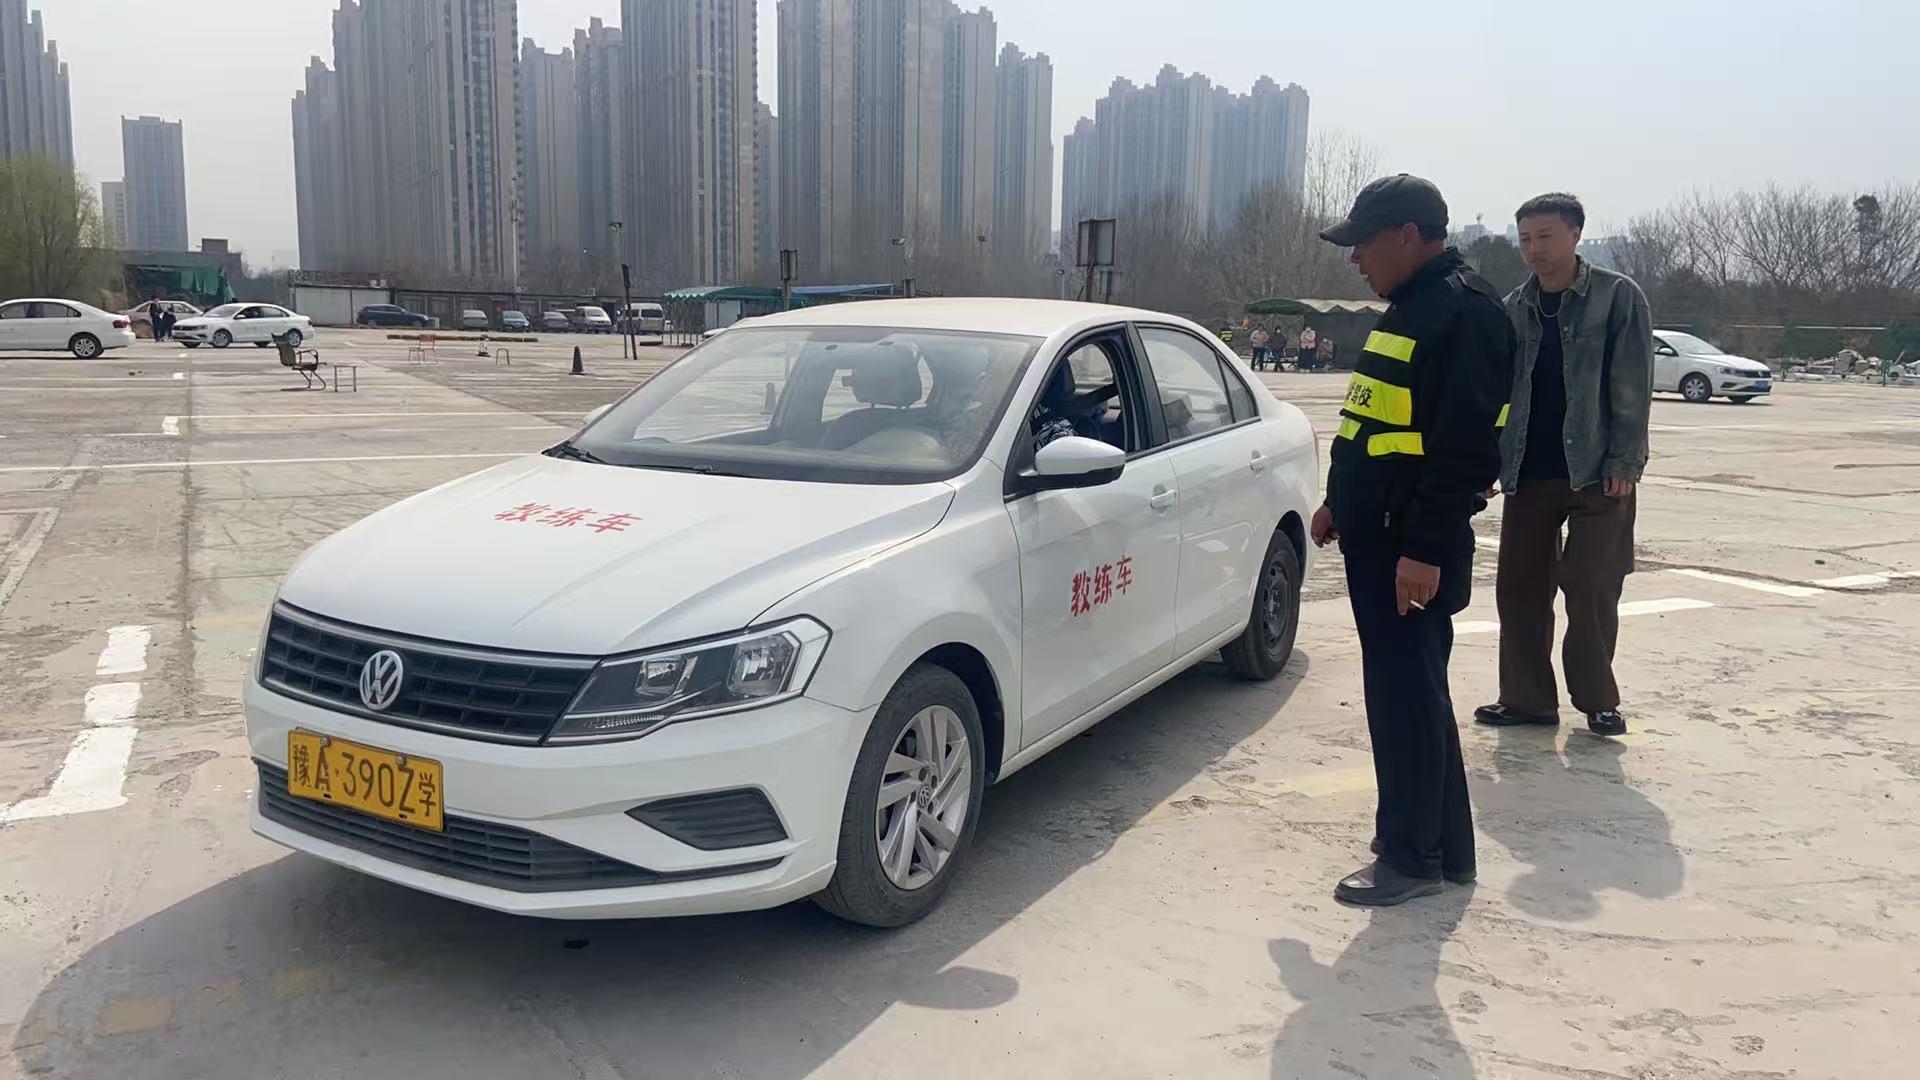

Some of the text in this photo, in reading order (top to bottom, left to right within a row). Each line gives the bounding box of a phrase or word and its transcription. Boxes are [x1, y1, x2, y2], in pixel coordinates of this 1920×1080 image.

[493, 502, 643, 533] 教练车
[1071, 555, 1132, 617] 教练车
